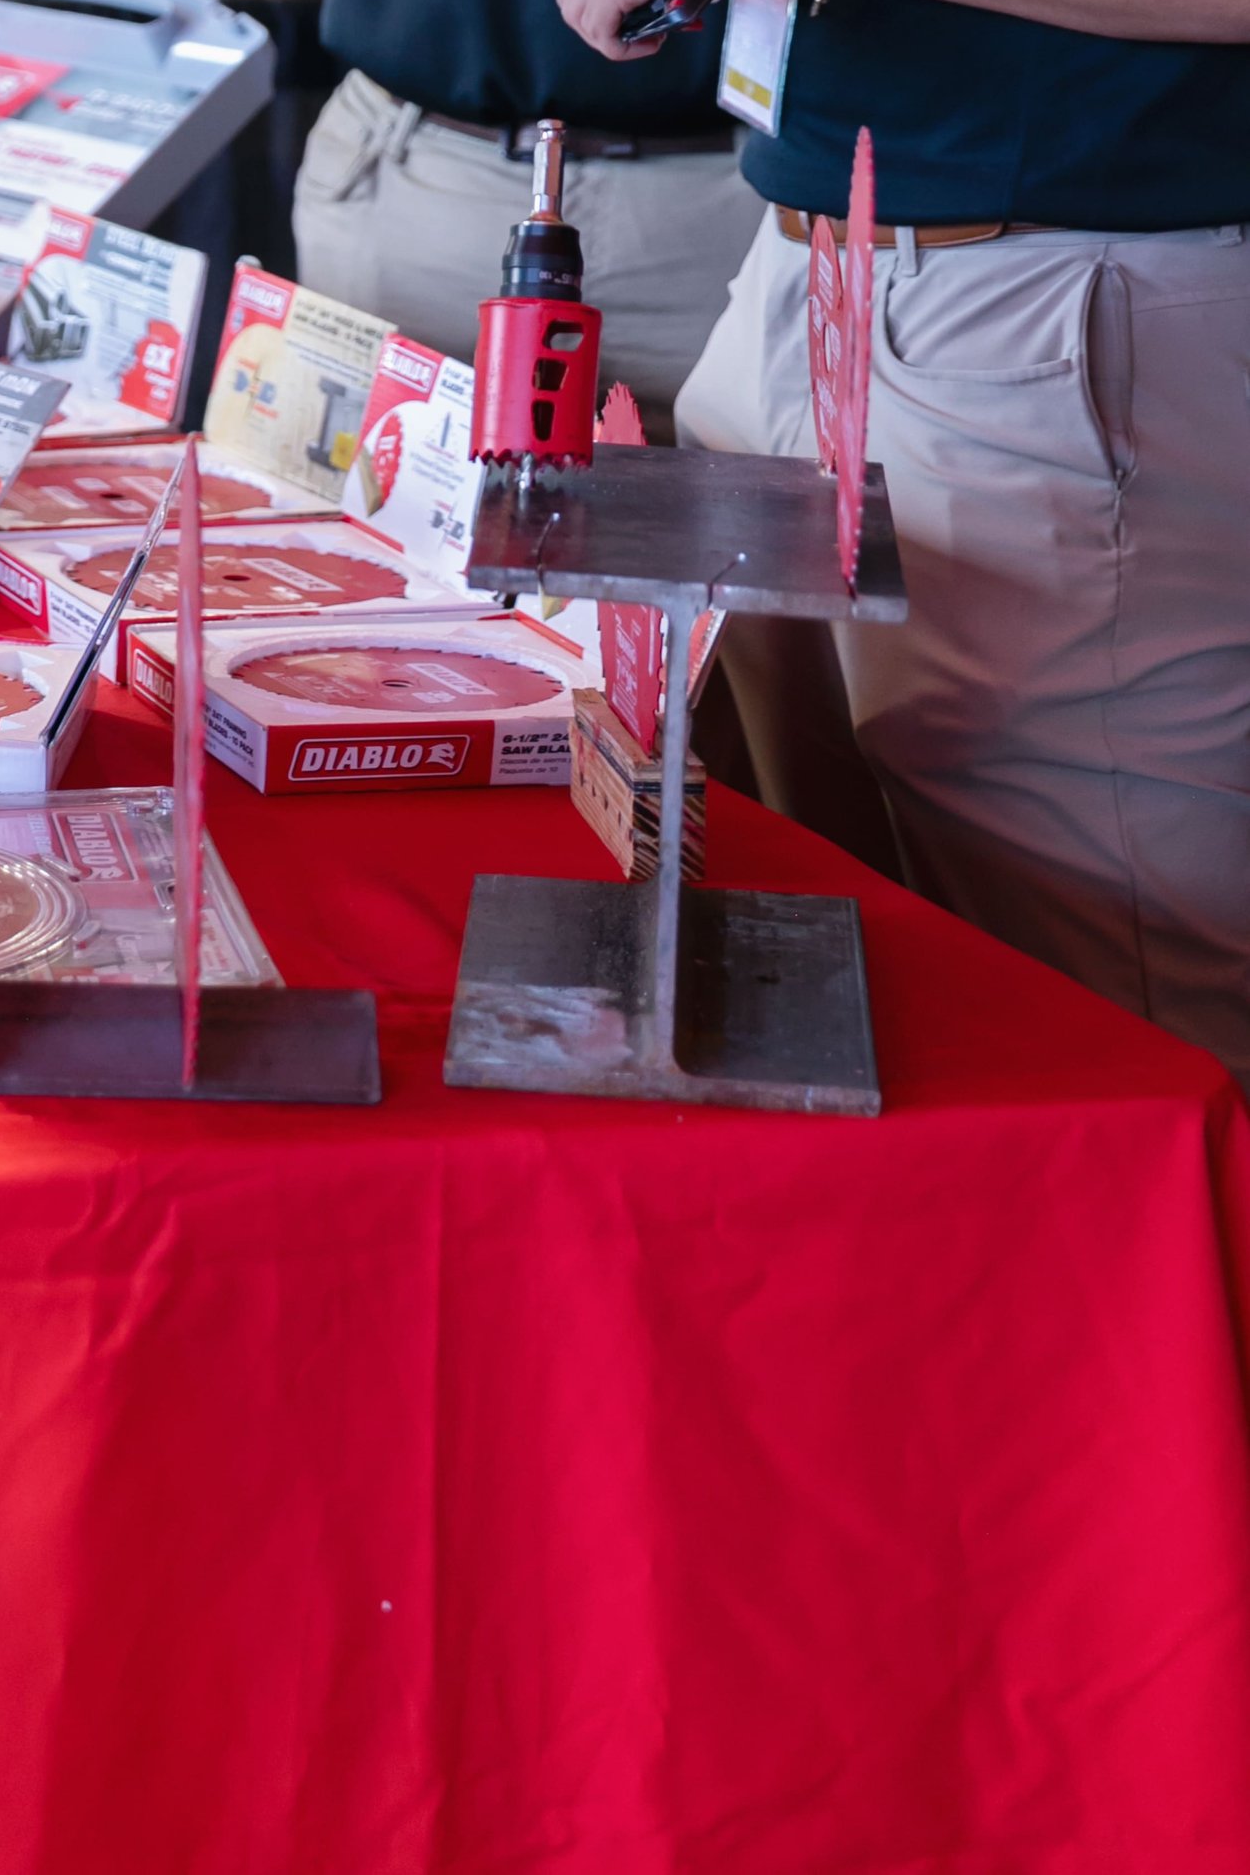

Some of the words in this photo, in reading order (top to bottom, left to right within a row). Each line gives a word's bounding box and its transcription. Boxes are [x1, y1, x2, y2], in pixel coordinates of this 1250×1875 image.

[502, 733, 549, 744] 6-1/2"
[300, 744, 423, 772] DIABLO
[501, 745, 535, 756] SAW
[66, 815, 119, 866] DIABLO
